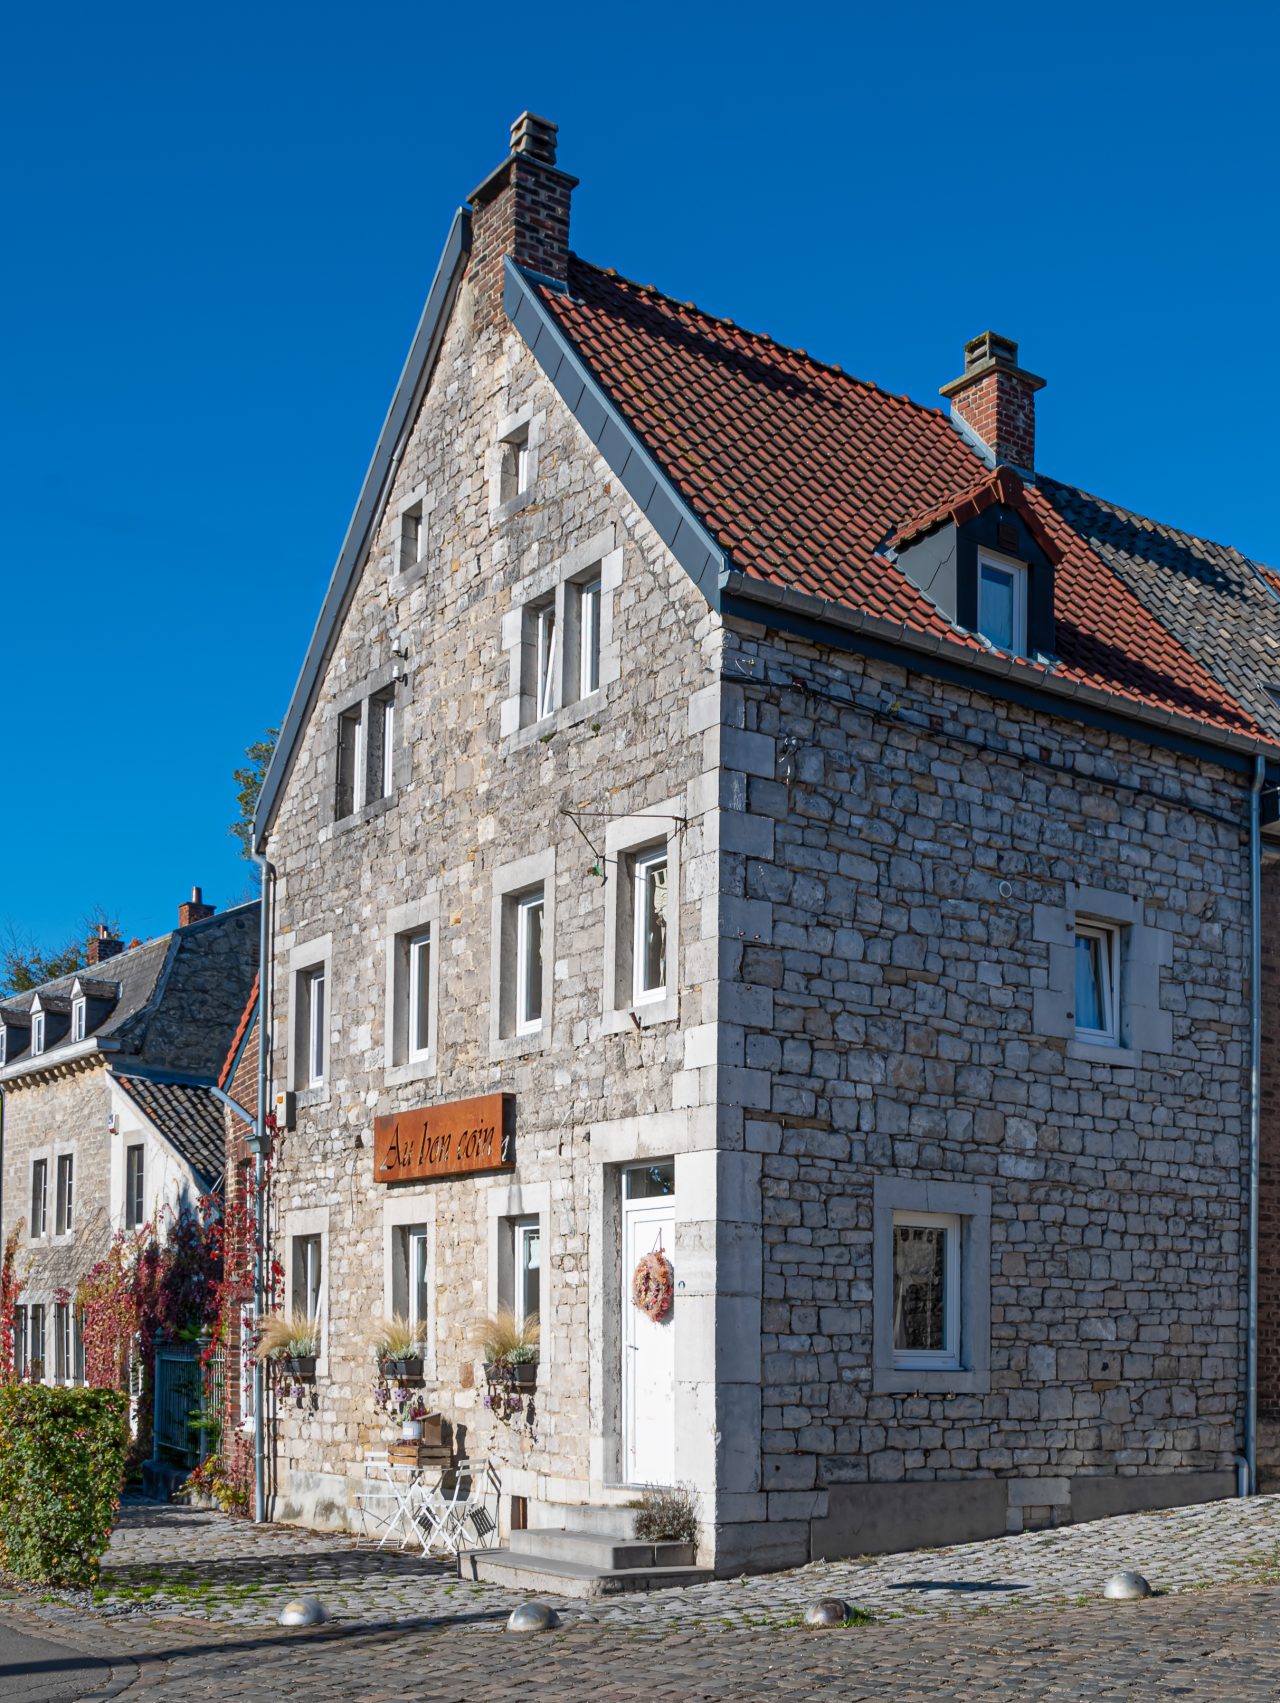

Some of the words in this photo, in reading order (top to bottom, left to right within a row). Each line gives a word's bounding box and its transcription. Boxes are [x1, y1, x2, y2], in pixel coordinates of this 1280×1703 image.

[379, 1122, 414, 1170] Au
[418, 1120, 452, 1166] bon
[457, 1118, 495, 1160] coin
